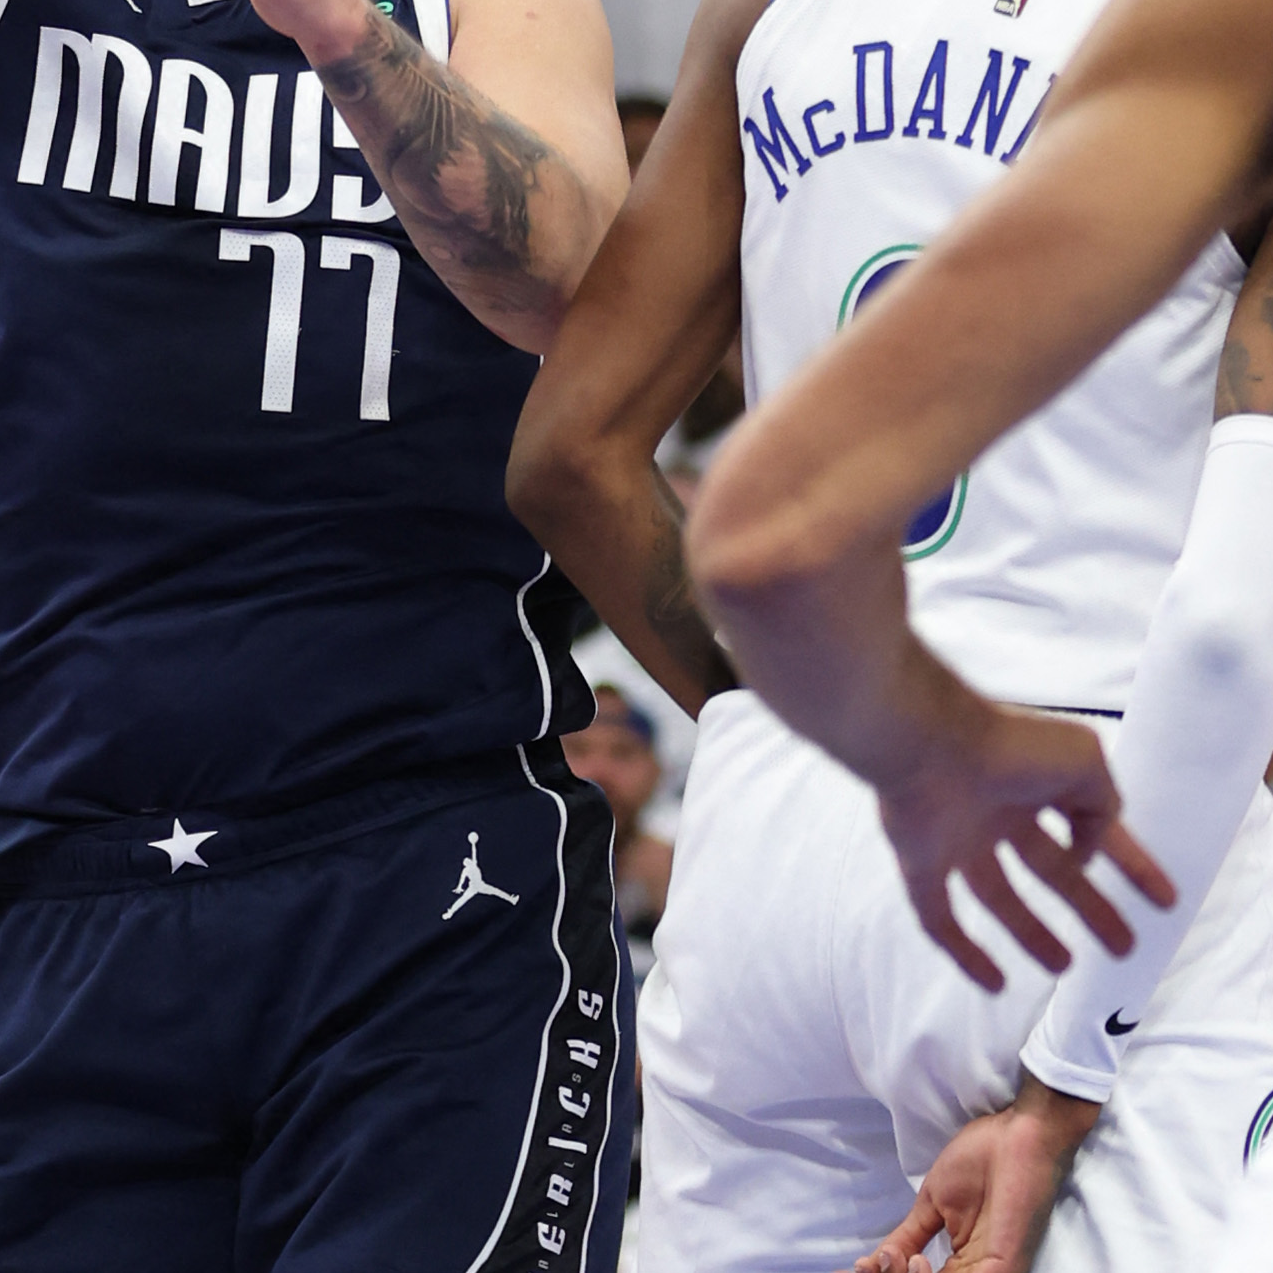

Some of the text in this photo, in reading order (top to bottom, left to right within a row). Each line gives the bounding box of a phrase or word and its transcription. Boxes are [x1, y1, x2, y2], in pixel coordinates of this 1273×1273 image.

[743, 38, 1059, 204] McDANI
[218, 228, 402, 421] 77
[536, 988, 604, 1256] ERICKS
[537, 1072, 582, 1270] ALLAS
